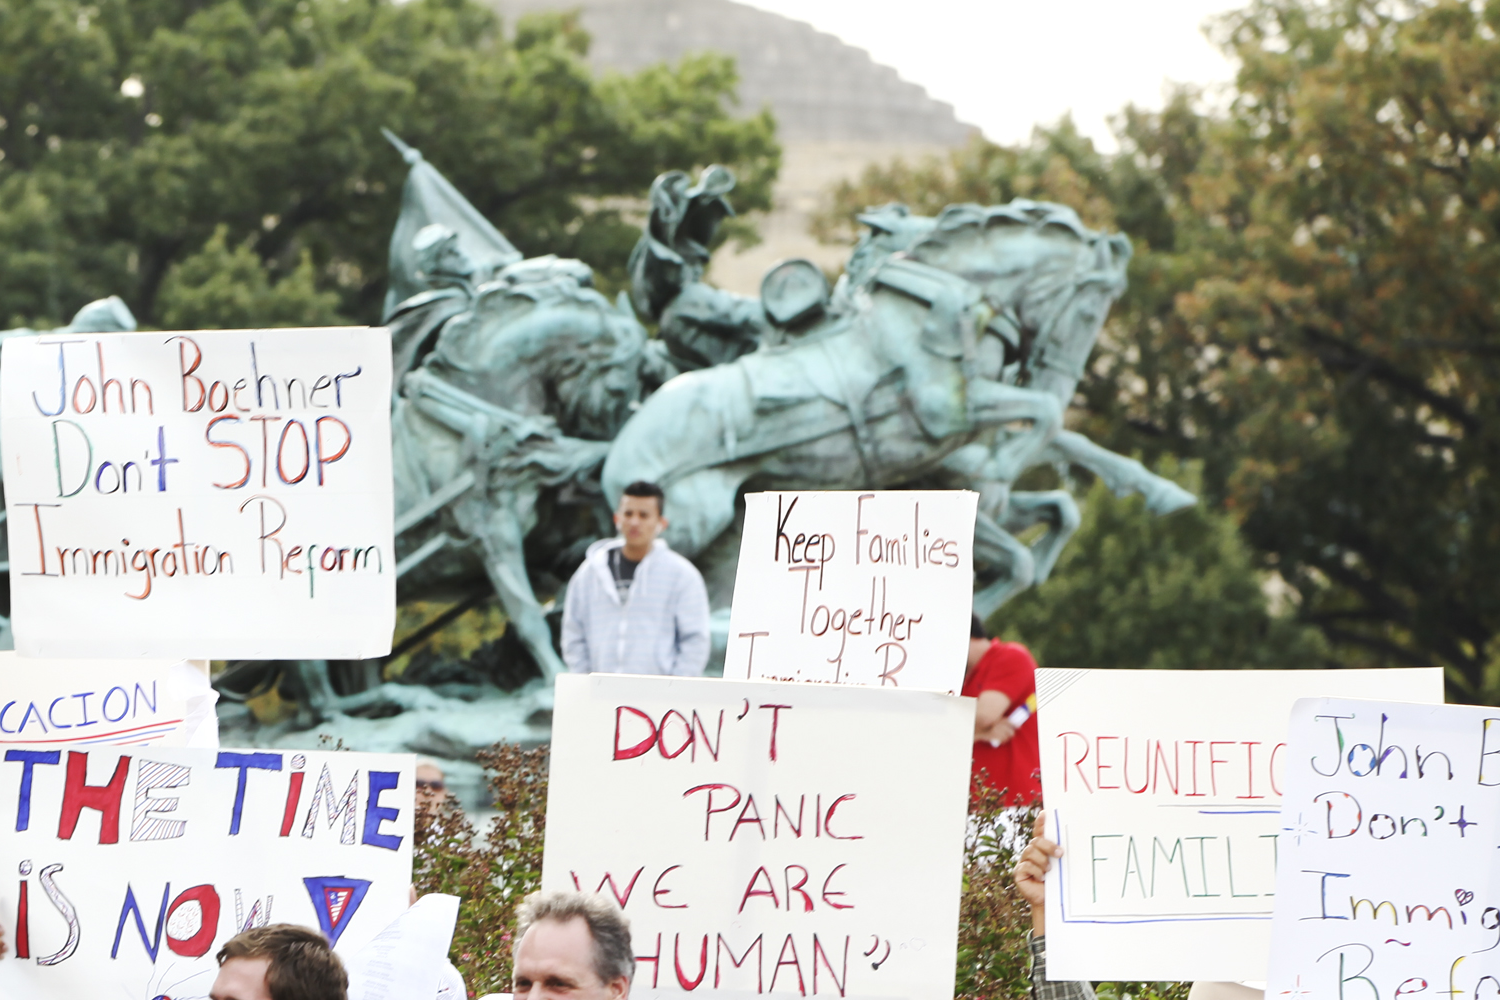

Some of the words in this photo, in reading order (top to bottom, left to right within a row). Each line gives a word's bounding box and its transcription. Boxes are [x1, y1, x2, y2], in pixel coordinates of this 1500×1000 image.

[32, 340, 154, 416] John
[164, 336, 362, 413] Boehner
[52, 418, 180, 498] Don't
[205, 413, 352, 490] STOP
[14, 502, 234, 600] Immigration
[239, 494, 382, 599] Reform
[774, 493, 836, 591] Keep
[855, 493, 960, 570] Families
[788, 564, 924, 664] Together
[612, 697, 793, 763] DON'T
[1056, 731, 1287, 799] REUNIFIC
[1311, 712, 1453, 781] John
[4, 749, 192, 846] THE
[682, 782, 866, 842] PANIC
[1313, 790, 1478, 840] Don't
[569, 864, 689, 910] WE
[737, 863, 855, 915] ARE
[1091, 834, 1279, 904] FAMILI
[110, 881, 274, 964] NOW
[1298, 869, 1500, 955] Immig
